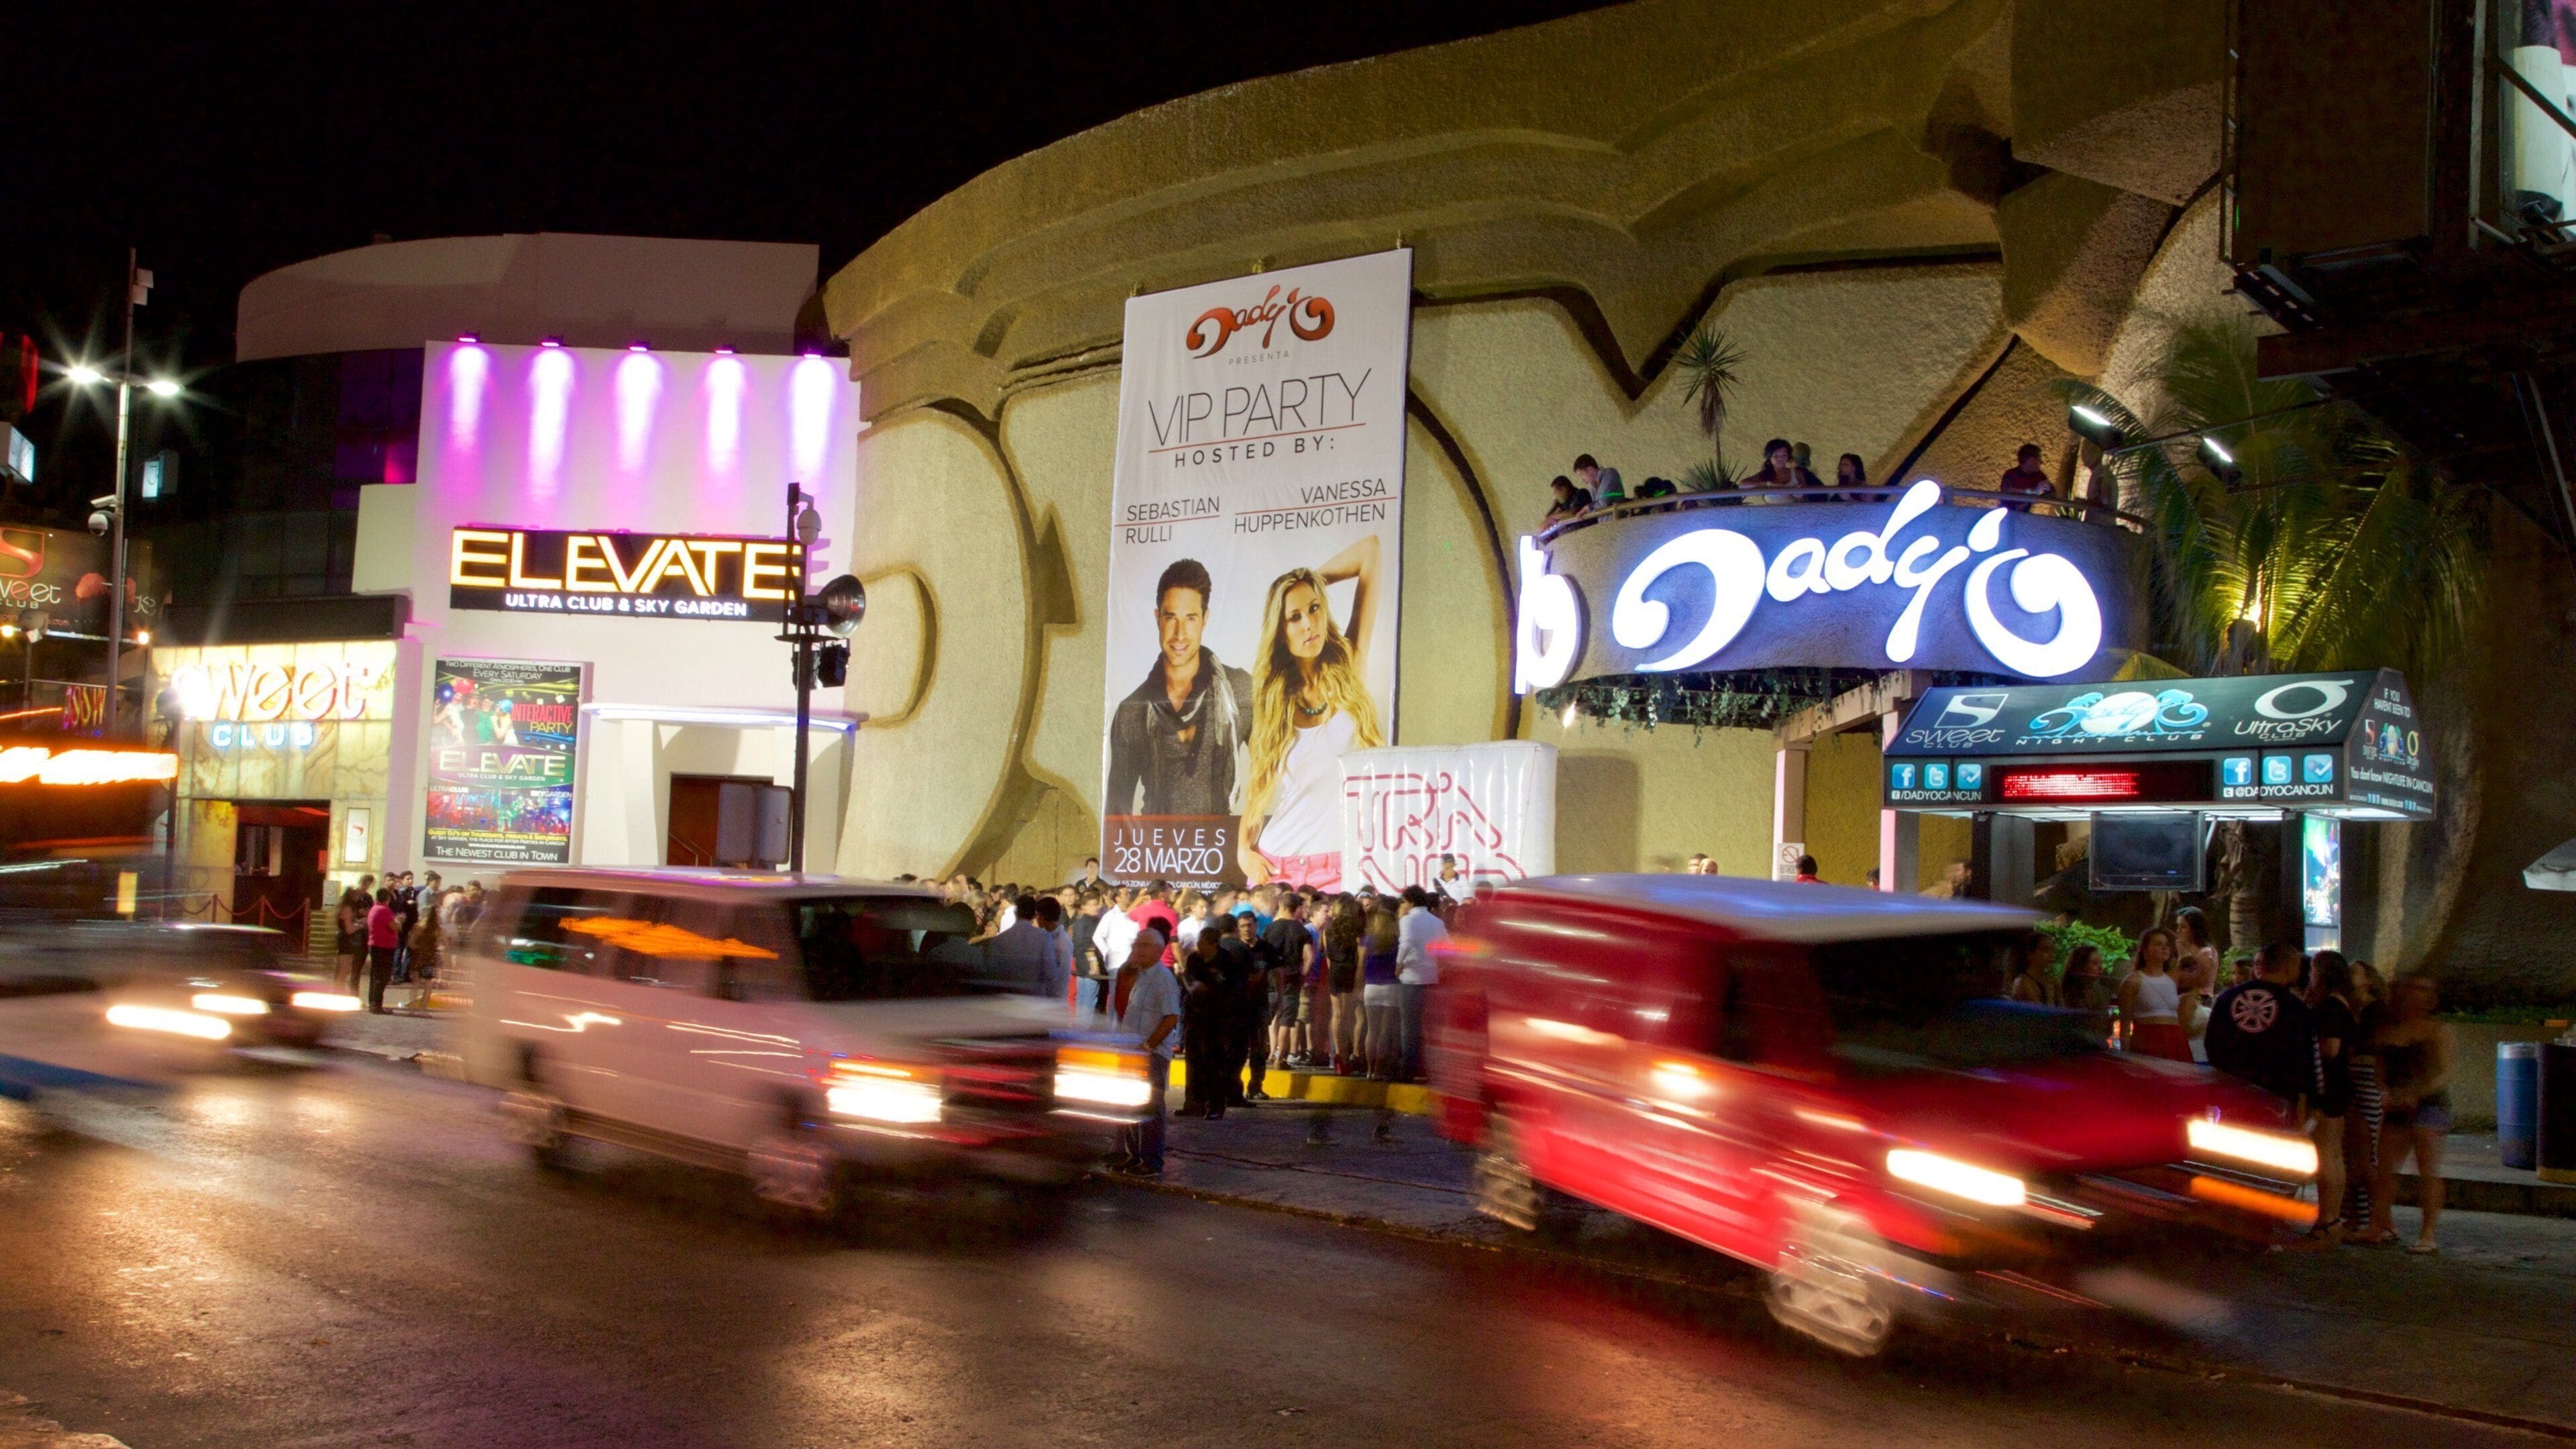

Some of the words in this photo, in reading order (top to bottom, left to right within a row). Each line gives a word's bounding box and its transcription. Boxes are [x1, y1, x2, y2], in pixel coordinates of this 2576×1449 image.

[1228, 351, 1290, 366] PRESENTA
[1148, 392, 1213, 446] VIP
[1224, 368, 1372, 437] PARTY
[1175, 441, 1275, 468] HOSTED
[1294, 435, 1335, 454] BY:
[1301, 478, 1387, 504] VANESSA
[1126, 496, 1220, 522] SEBASTIAN
[1234, 502, 1385, 534] HUPPENKOTHEN
[1125, 525, 1172, 544] RULLI
[449, 529, 802, 600] ELEVATE
[0, 598, 39, 609] LUB
[505, 593, 562, 609] ULTRA
[567, 594, 613, 611] CLUB
[618, 597, 630, 611] &
[635, 597, 669, 613] SKY
[674, 600, 747, 617] GARDEN
[473, 668, 500, 678] EVERY
[500, 670, 542, 680] SATURDAY
[512, 703, 574, 723] INTERACTIVE
[212, 724, 314, 747] CLUB
[530, 721, 572, 733] PARTY
[1906, 729, 2006, 744] sweet
[2259, 731, 2306, 739] CLUB
[2016, 737, 2106, 745] NIGHT
[2124, 733, 2203, 743] CLUB
[439, 751, 566, 776] ELEVATE
[1114, 828, 1226, 847] JUEVES
[435, 846, 453, 856] THE
[455, 847, 492, 858] NEWEST
[494, 850, 518, 859] CLUB
[519, 851, 529, 859] IN
[531, 850, 558, 861] TOWN
[1114, 847, 1141, 873] 28
[1145, 847, 1224, 875] MARZO
